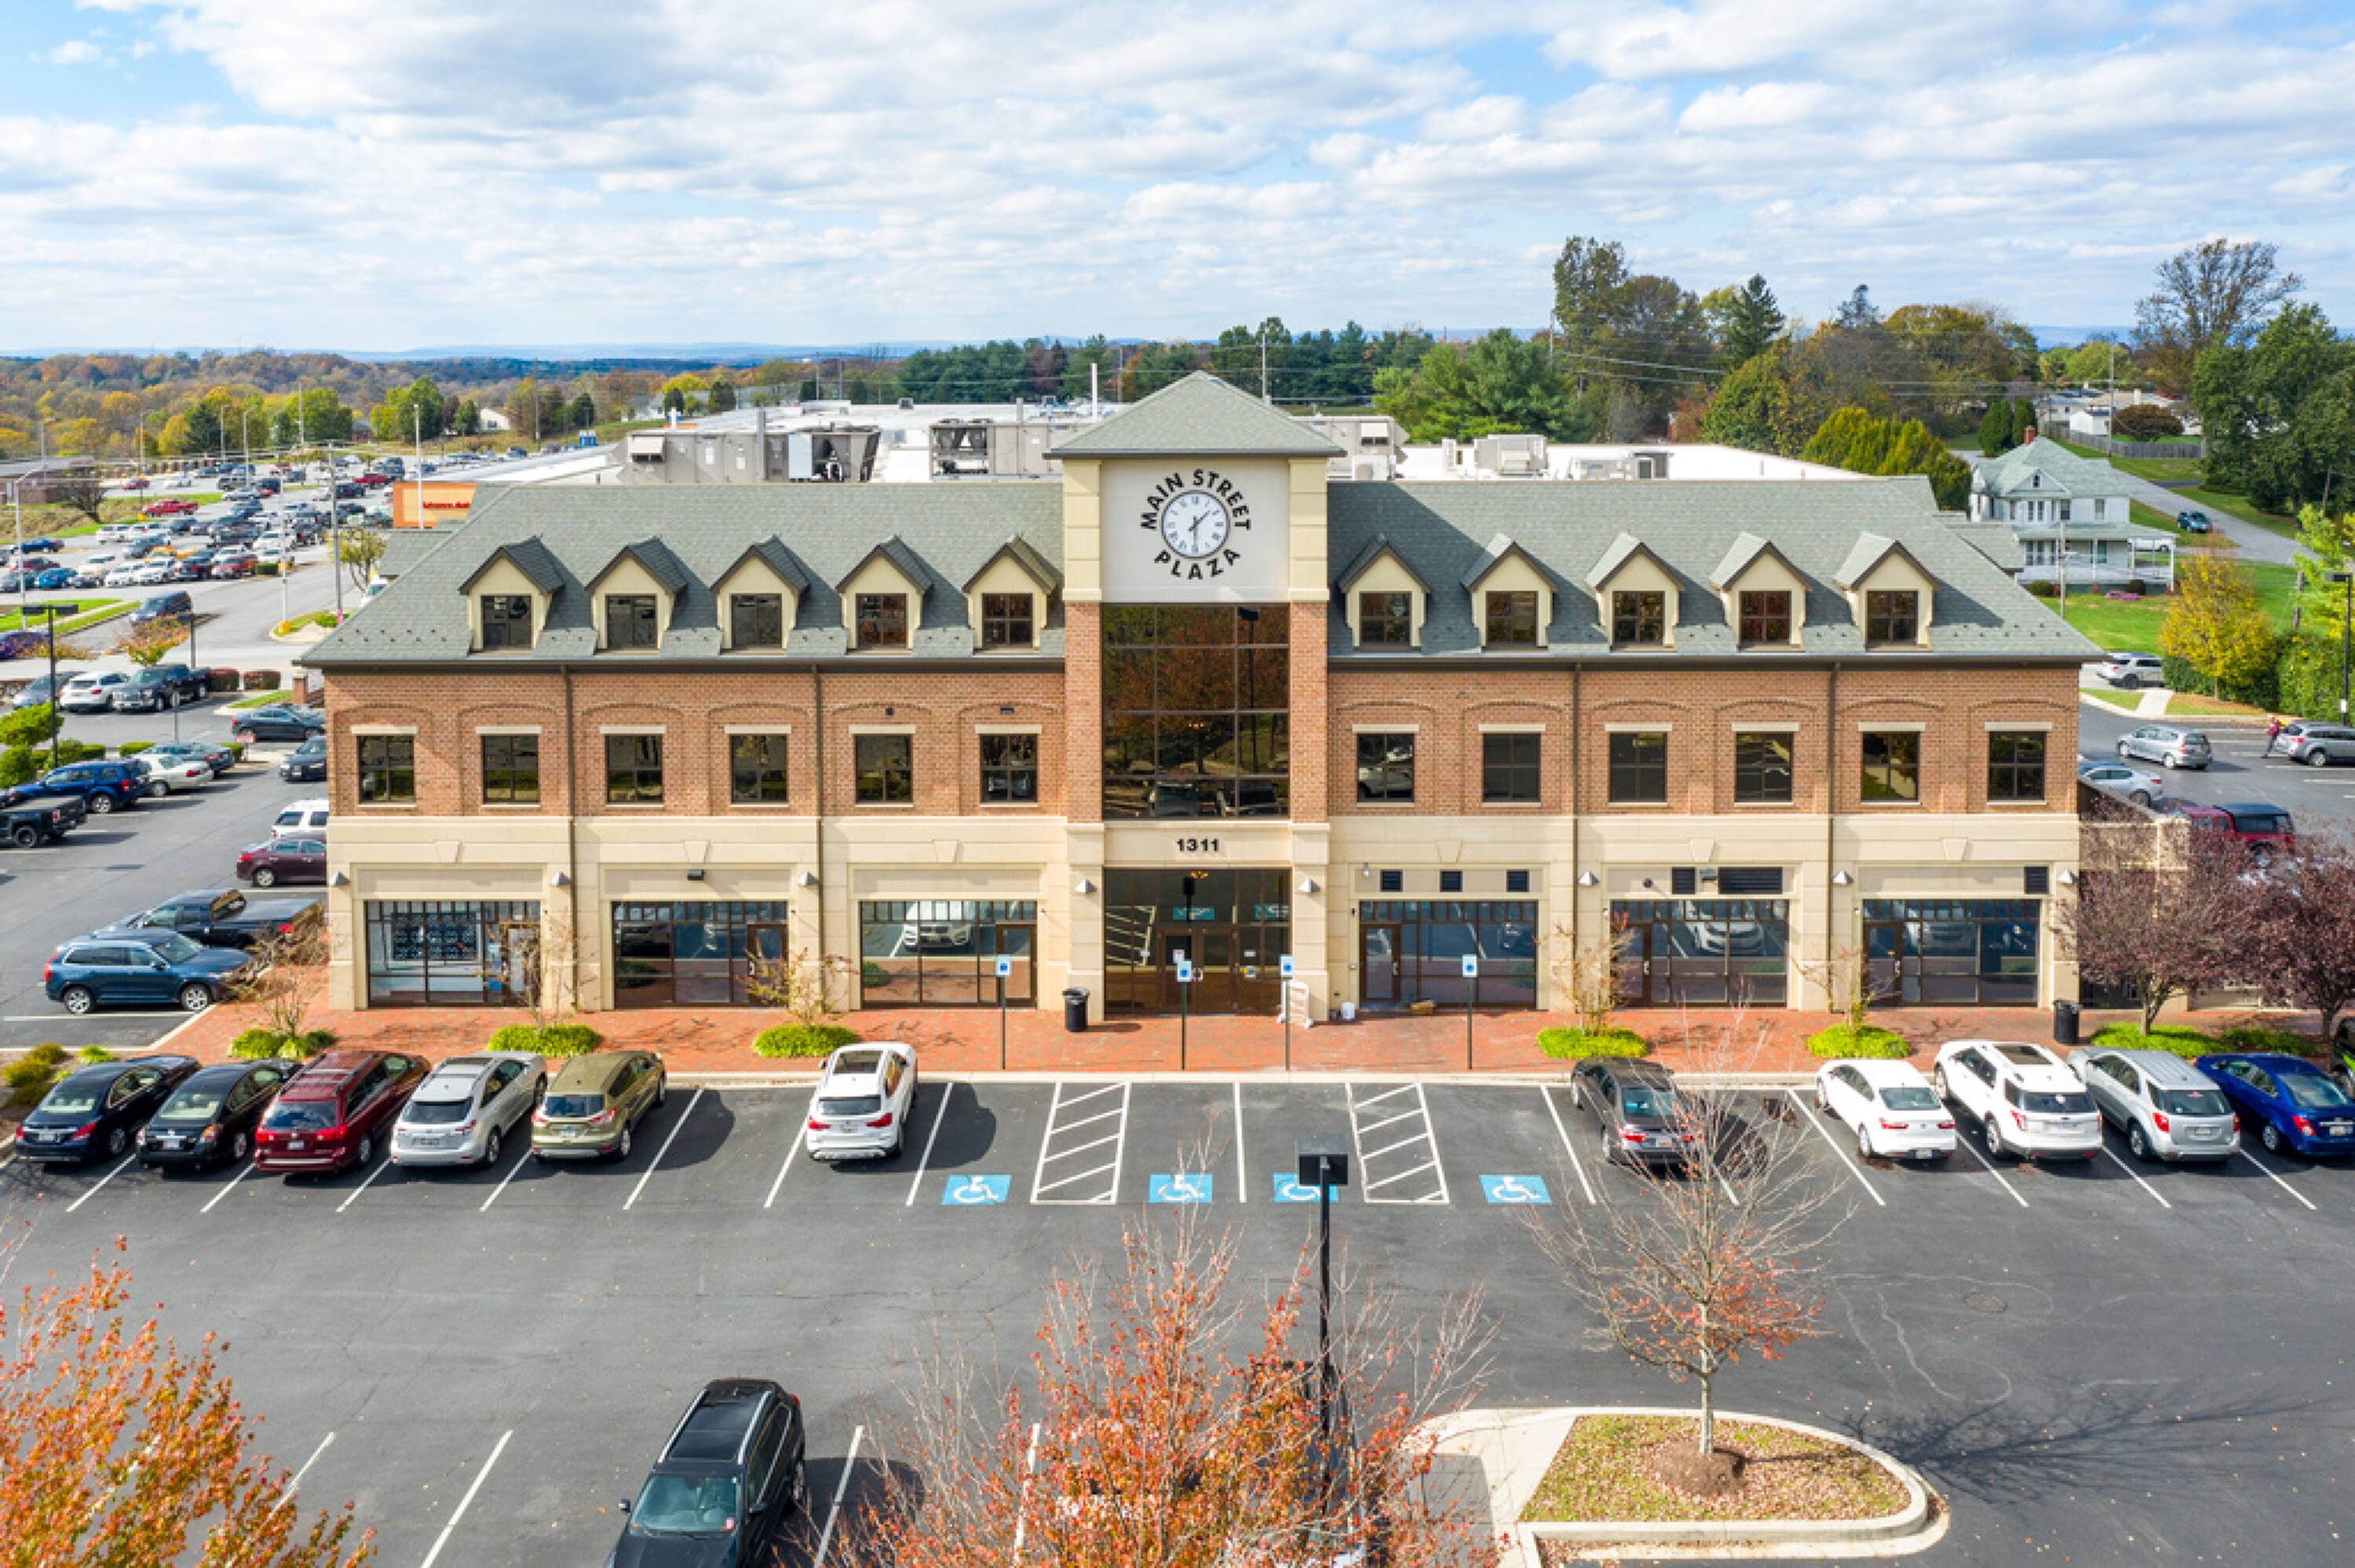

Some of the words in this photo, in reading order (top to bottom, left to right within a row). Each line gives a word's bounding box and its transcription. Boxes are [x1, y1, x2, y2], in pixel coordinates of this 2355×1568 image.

[1141, 473, 1184, 531] MAIN
[1193, 469, 1251, 530] STREET
[1154, 549, 1240, 580] PLAZA
[1177, 838, 1219, 851] 1311
